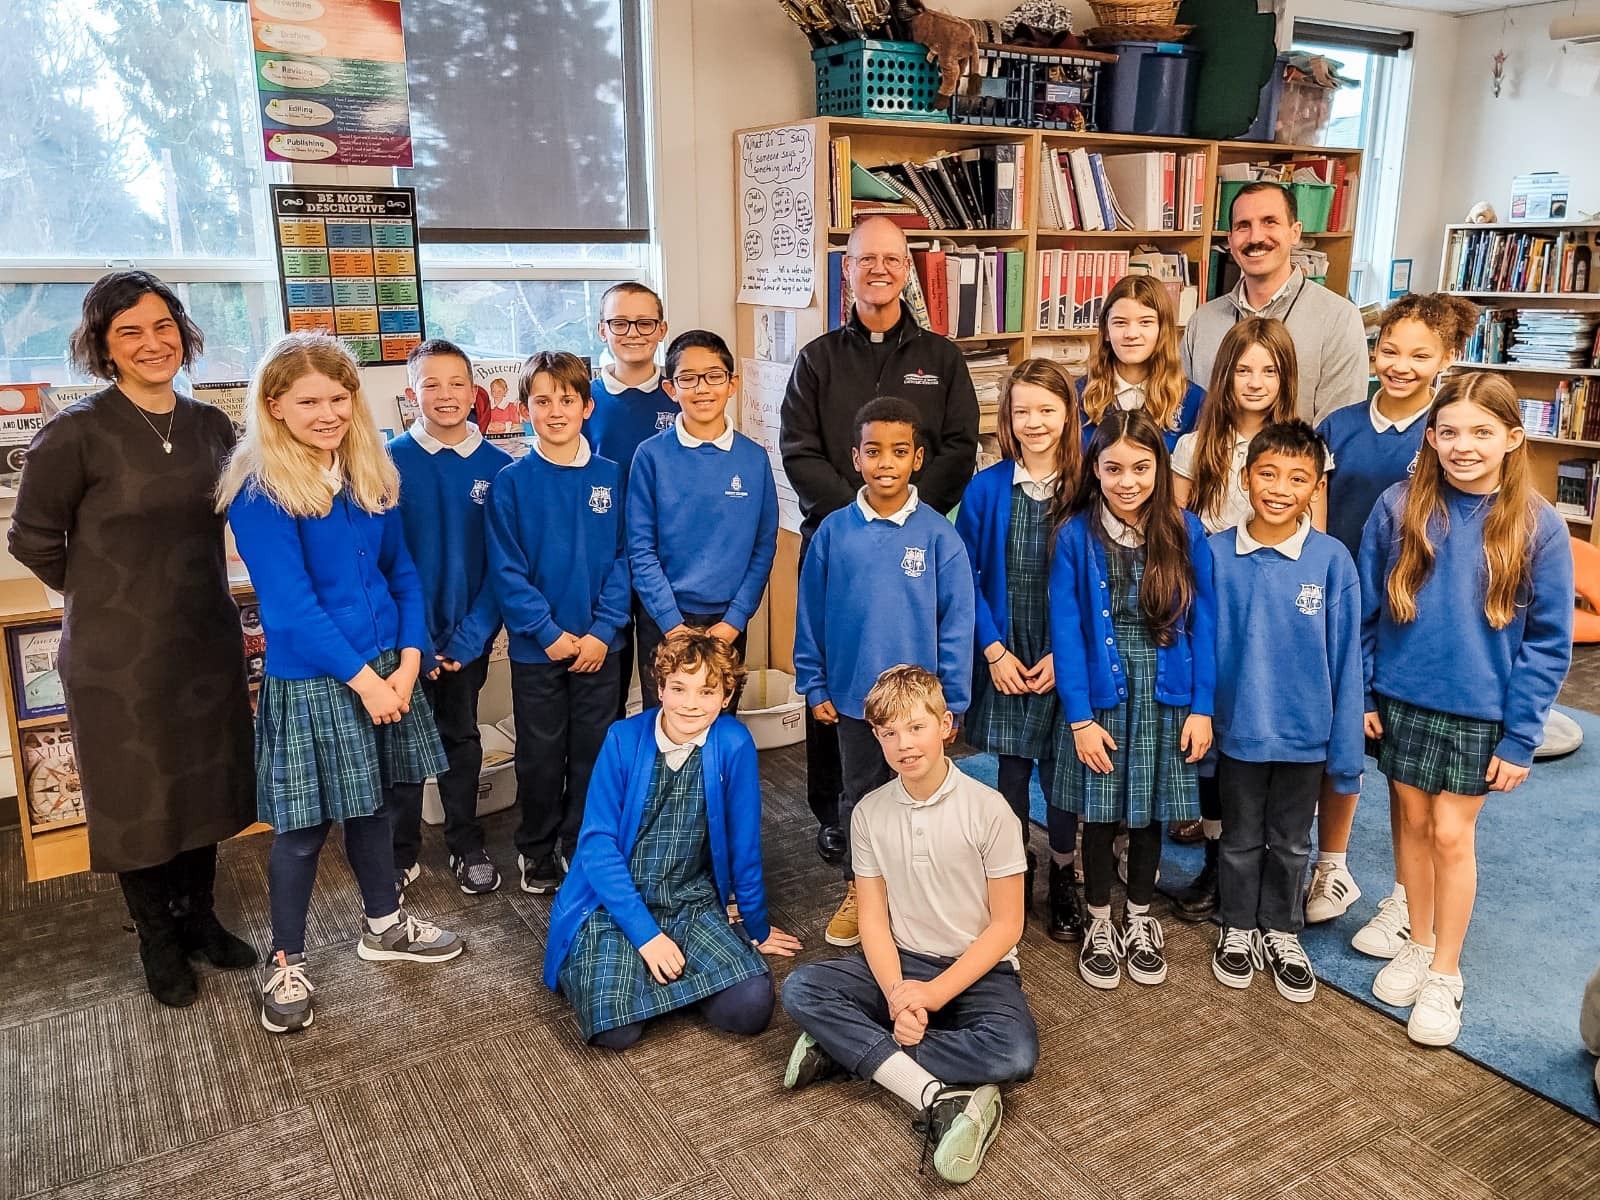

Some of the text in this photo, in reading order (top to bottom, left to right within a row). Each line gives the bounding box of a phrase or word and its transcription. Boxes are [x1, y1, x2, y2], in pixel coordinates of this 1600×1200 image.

[288, 104, 313, 113] Editing
[286, 138, 325, 147] Publishing
[317, 193, 374, 204] BE MORE
[306, 203, 386, 214] DESCRIPTIVE
[477, 362, 522, 379] Butterfl
[17, 418, 45, 430] UNSE
